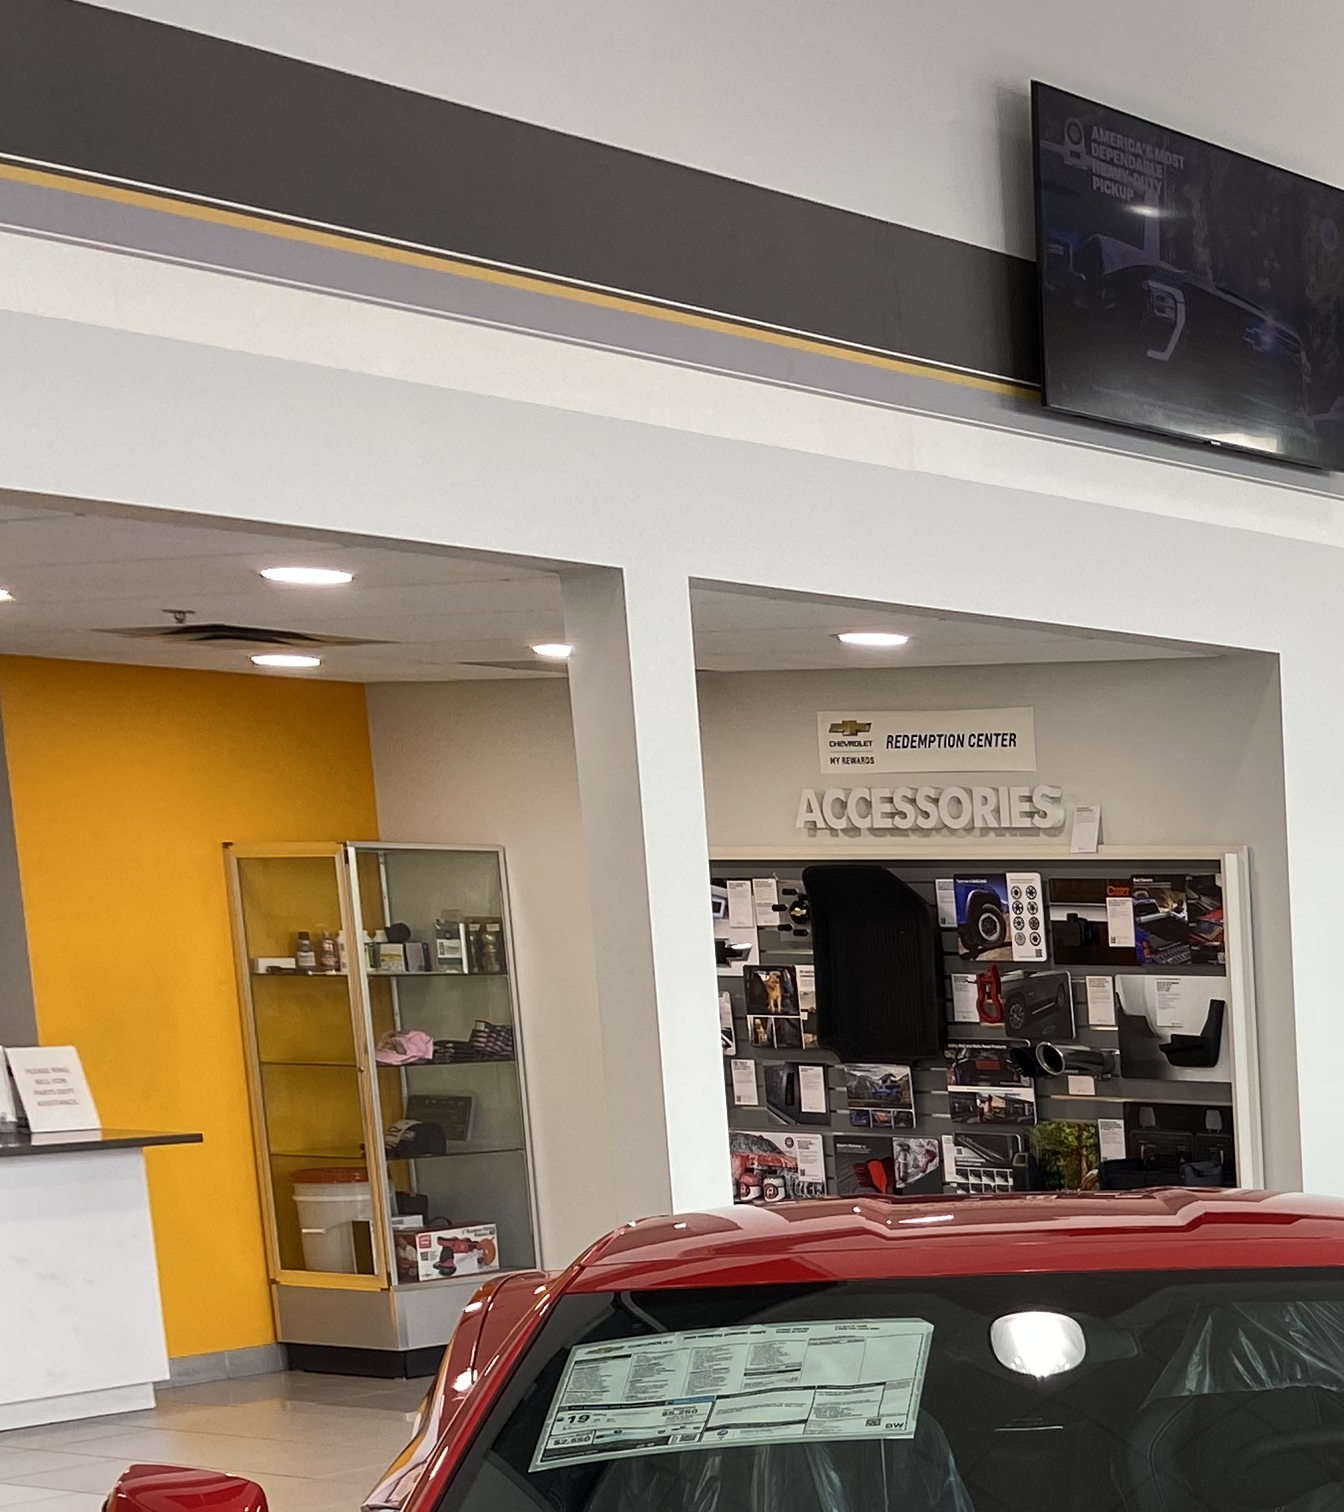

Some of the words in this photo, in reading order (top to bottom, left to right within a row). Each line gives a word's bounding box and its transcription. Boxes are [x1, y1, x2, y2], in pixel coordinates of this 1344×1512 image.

[1091, 126, 1153, 159] AMERICA'S
[1154, 148, 1185, 170] MOST
[1091, 142, 1163, 178] DEPENDABLE
[1092, 160, 1162, 194] HEAVY-DUTY
[1092, 176, 1134, 200] PICKUP
[829, 740, 873, 748] CHEVROLET
[886, 733, 965, 750] REDEMPTION
[968, 732, 1017, 748] CENTER
[830, 756, 840, 765] MY
[842, 756, 875, 765] REWARDS
[795, 785, 1065, 830] ACCESSORIES
[566, 1414, 591, 1424] 19
